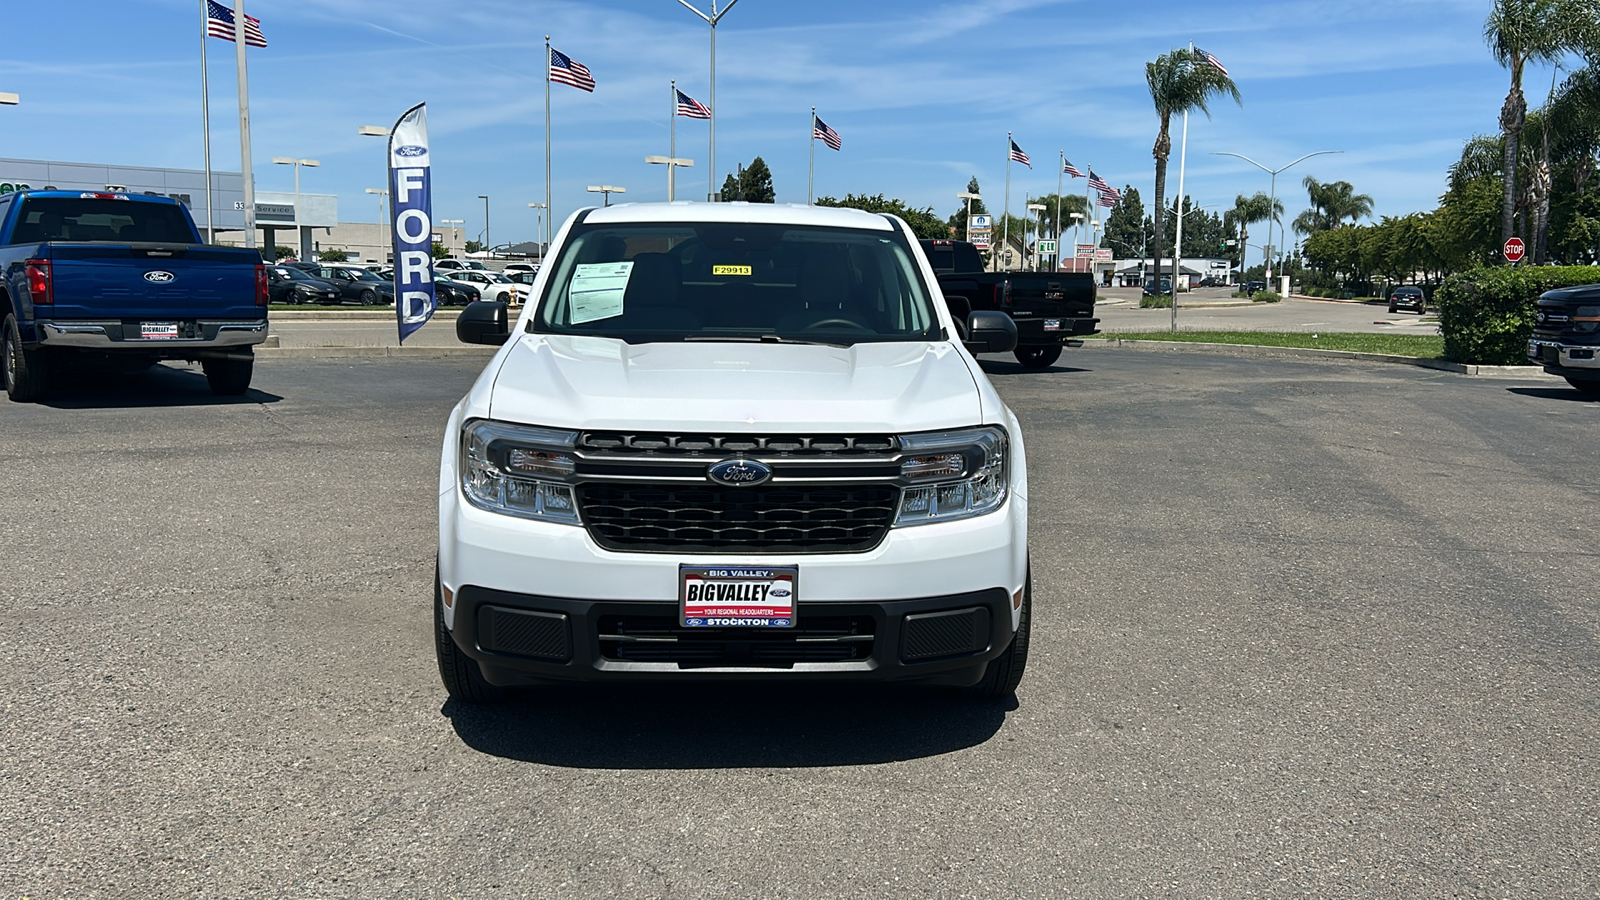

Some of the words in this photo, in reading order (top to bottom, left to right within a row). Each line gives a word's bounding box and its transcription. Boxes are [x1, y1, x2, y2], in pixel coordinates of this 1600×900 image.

[400, 147, 423, 157] Ford
[257, 205, 291, 213] Service
[396, 168, 432, 325] FORD
[1505, 244, 1523, 254] STOP
[714, 266, 750, 274] F29913
[149, 271, 169, 281] Ford
[723, 465, 756, 481] Ford
[771, 589, 789, 597] Ford
[717, 608, 739, 616] REGIONAL
[739, 608, 774, 616] HEADQUARTERS
[707, 618, 769, 626] STOCKTON
